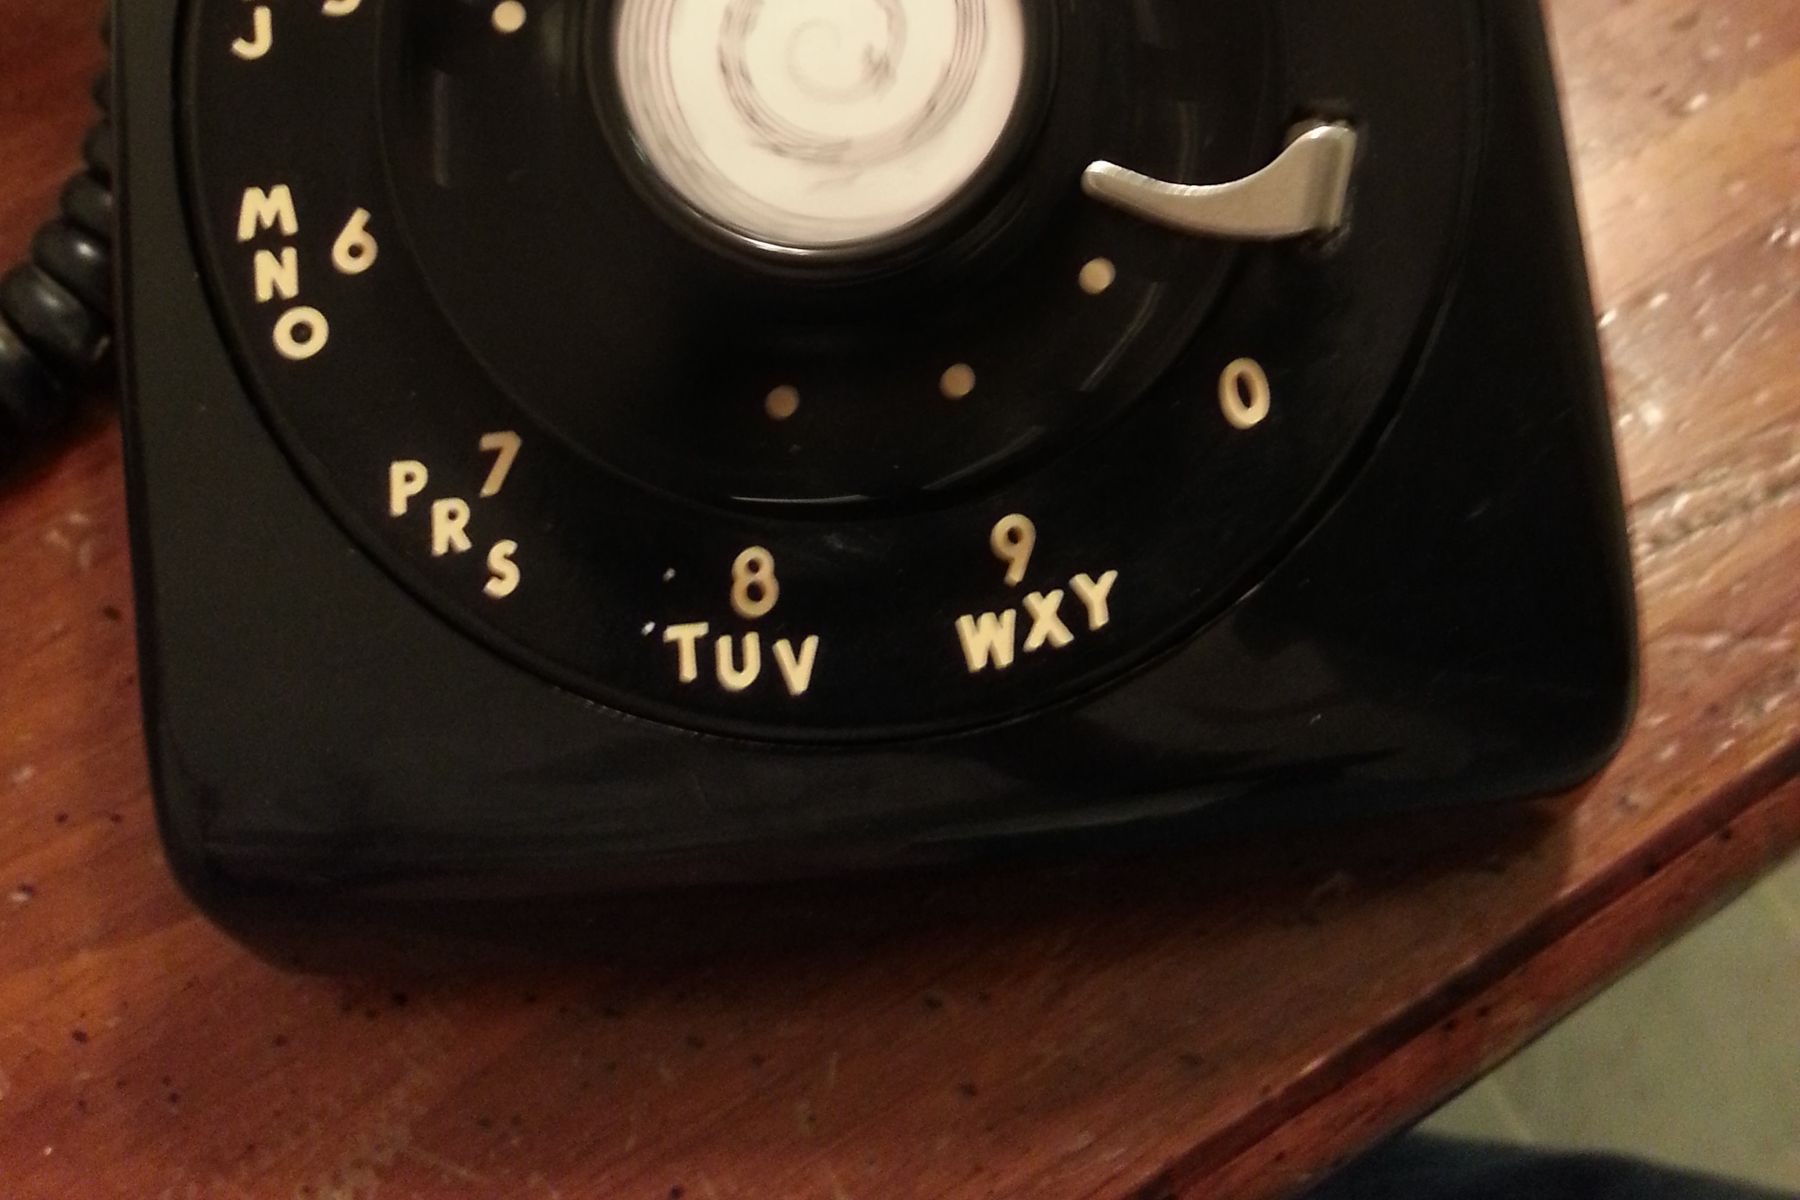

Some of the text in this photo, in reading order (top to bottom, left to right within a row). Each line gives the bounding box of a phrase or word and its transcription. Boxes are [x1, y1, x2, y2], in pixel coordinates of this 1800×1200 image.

[331, 207, 378, 275] 6
[480, 433, 522, 497] 7
[388, 459, 521, 598] PRS
[991, 512, 1034, 584] 9
[732, 545, 779, 617] 8
[955, 569, 1119, 672] WXY
[662, 621, 820, 696] TUV
